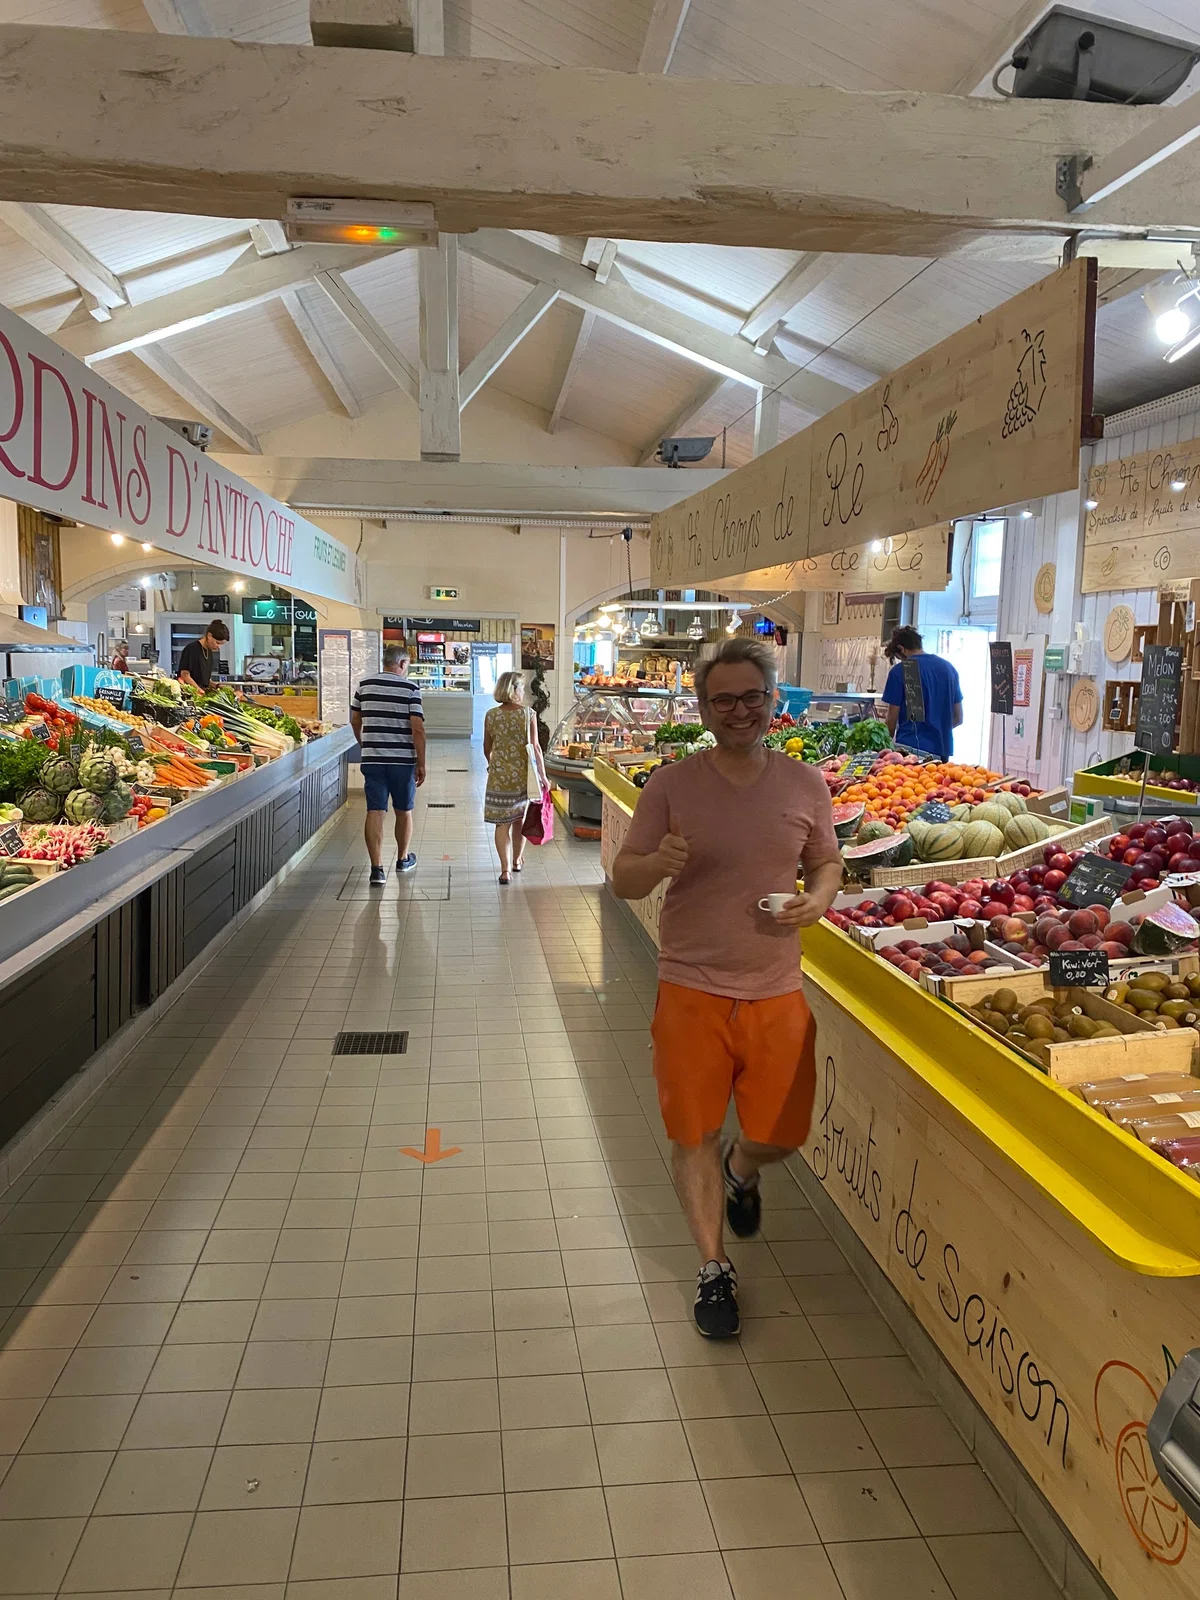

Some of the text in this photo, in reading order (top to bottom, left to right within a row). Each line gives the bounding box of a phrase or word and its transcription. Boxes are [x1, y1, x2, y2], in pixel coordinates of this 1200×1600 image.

[165, 444, 295, 577] D'ANTIOCHE
[711, 493, 762, 569] Champs
[773, 466, 794, 541] de
[822, 432, 864, 526] Ré
[1129, 501, 1138, 519] de
[1148, 498, 1173, 526] fruits
[1179, 492, 1189, 512] de
[252, 604, 275, 619] Le
[1142, 677, 1157, 697] LOCAL
[1062, 959, 1080, 970] Kiwi
[813, 1055, 884, 1223] fruits
[895, 1159, 929, 1281] de
